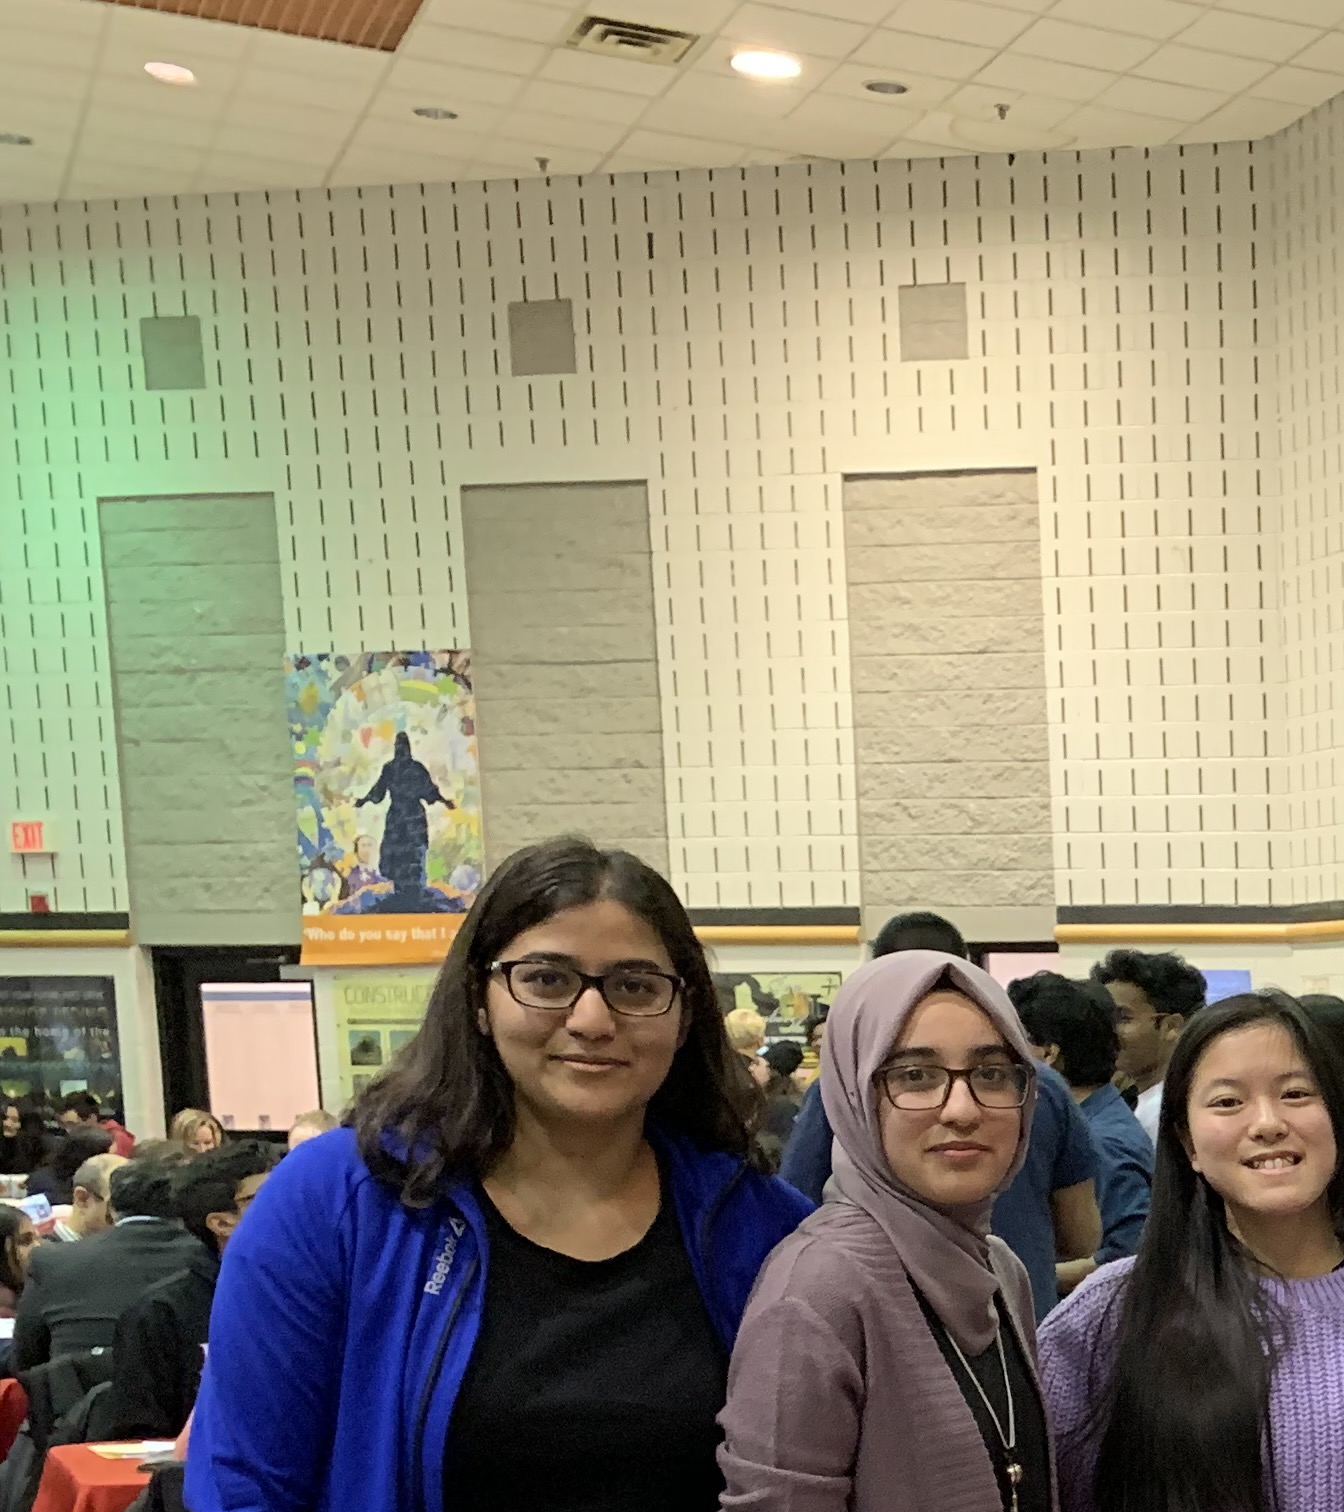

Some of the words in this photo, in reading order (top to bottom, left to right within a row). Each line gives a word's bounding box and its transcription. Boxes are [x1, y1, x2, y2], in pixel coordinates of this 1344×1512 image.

[339, 927, 356, 941] do
[359, 929, 382, 944] you
[385, 929, 408, 943] say
[411, 926, 437, 940] that
[423, 1234, 458, 1295] Reebok
